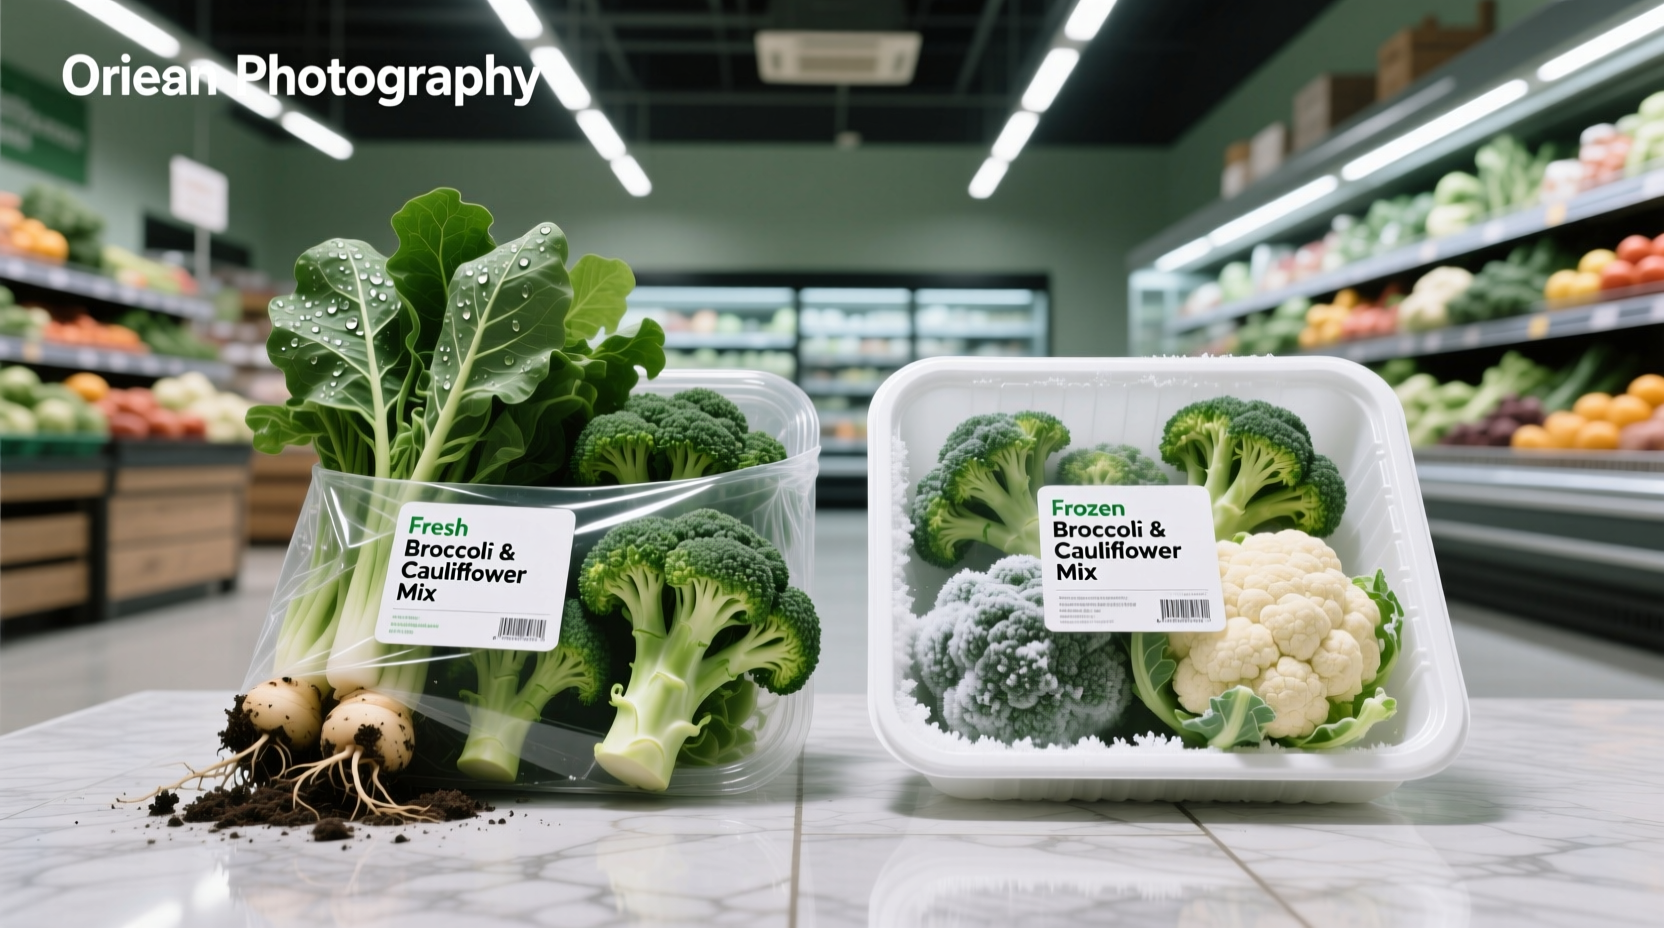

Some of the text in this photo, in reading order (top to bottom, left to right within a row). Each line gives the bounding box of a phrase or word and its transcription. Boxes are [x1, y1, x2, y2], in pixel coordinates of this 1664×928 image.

[1052, 499, 1125, 516] Frozen
[409, 516, 469, 537] Fresh
[1053, 520, 1166, 538] Broccoli &
[404, 539, 516, 561] Broccoli &
[1056, 562, 1098, 581] Mix
[396, 583, 437, 602] Mix
